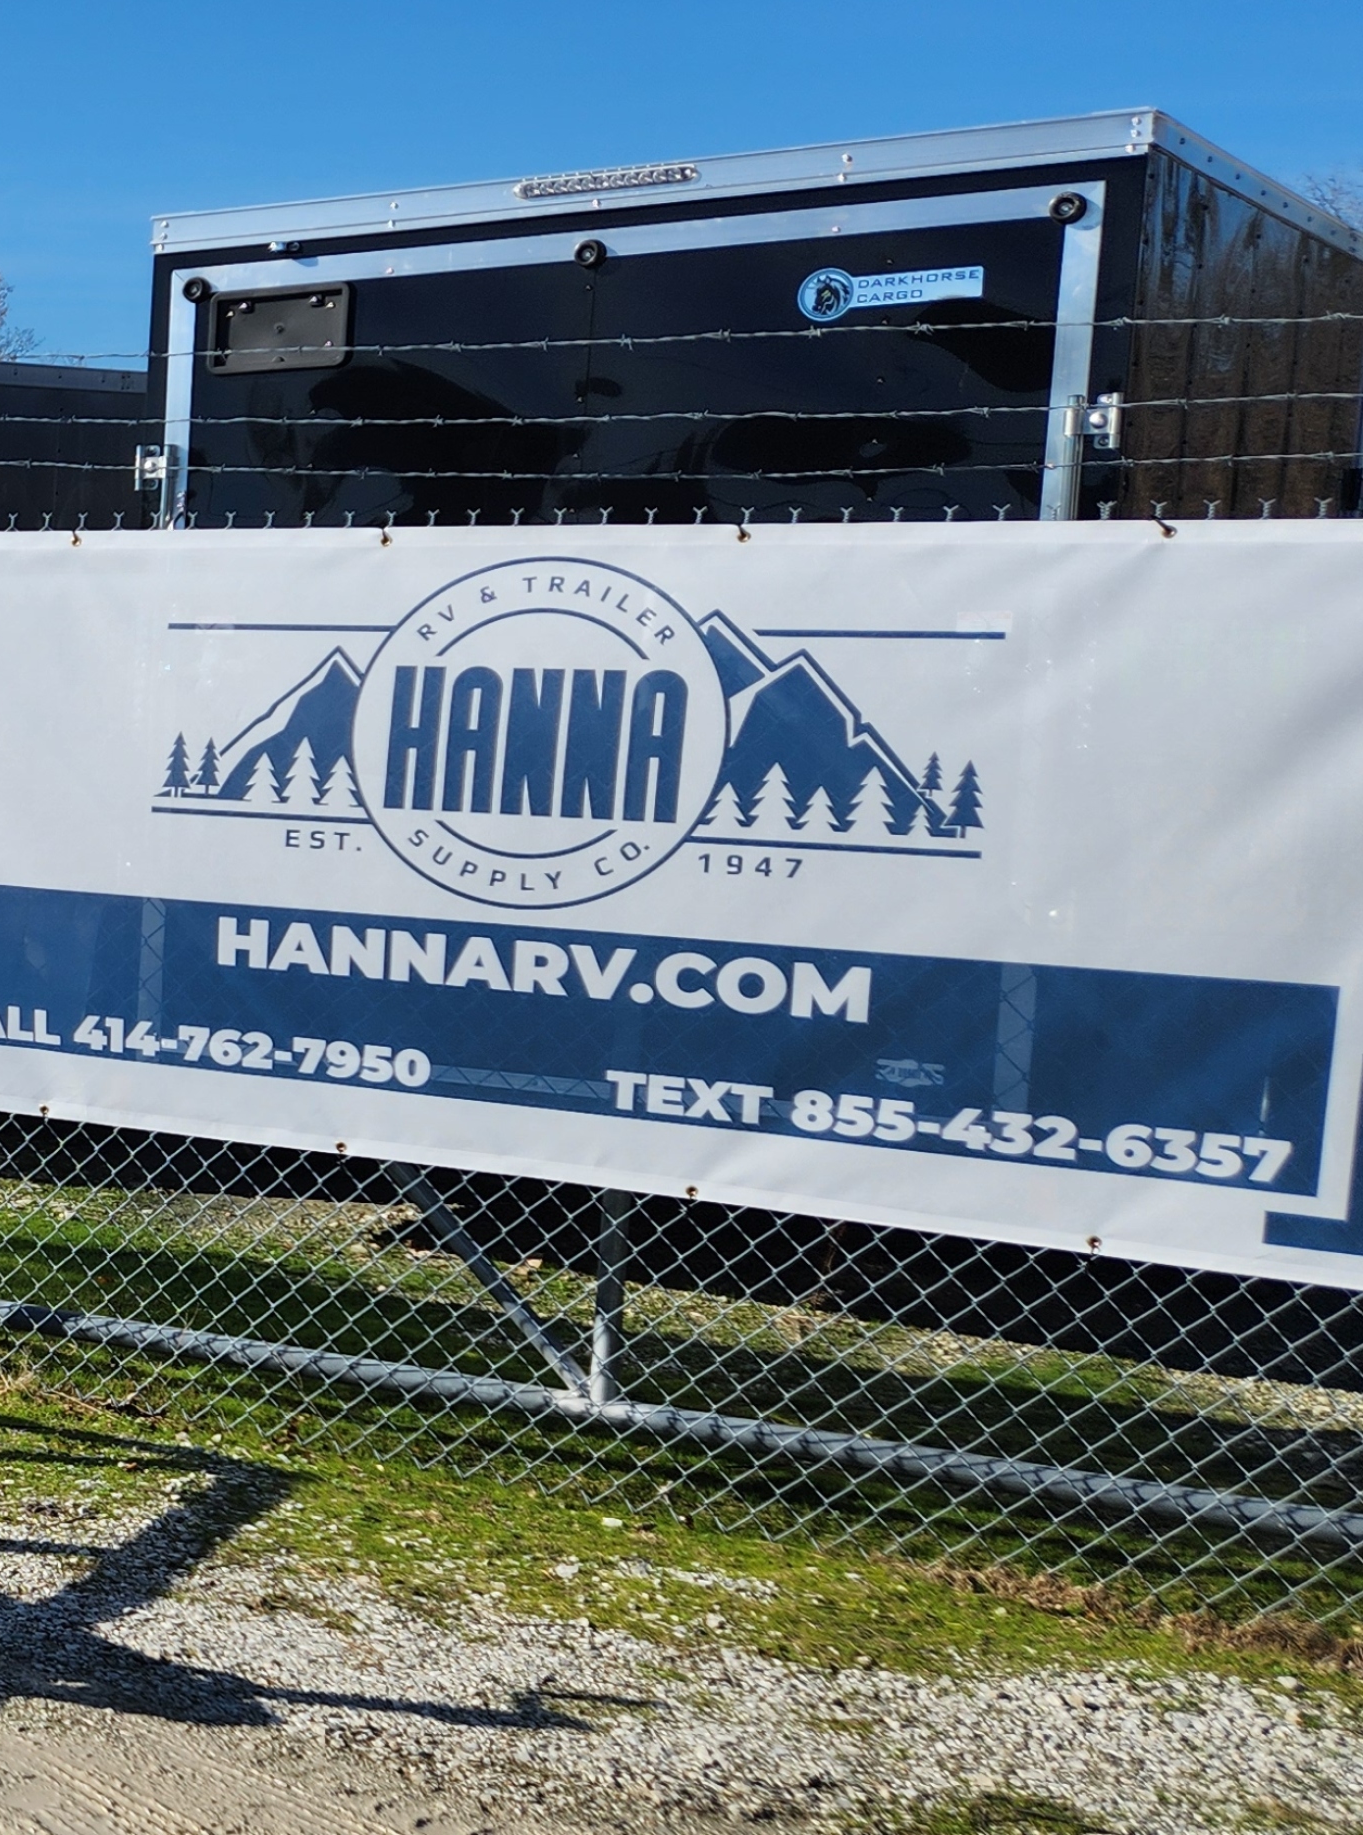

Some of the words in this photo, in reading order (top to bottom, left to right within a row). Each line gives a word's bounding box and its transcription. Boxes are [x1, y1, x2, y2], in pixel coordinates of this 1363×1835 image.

[857, 289, 922, 304] CARGO
[858, 269, 980, 289] DARKHORSE
[417, 604, 455, 642] RV
[480, 585, 497, 604] &
[522, 576, 676, 645] TRAILER
[383, 665, 689, 824] HANNA
[284, 829, 364, 852] EST.
[408, 828, 562, 891] SUPPLY
[594, 841, 650, 877] CO.
[697, 852, 806, 880] 1947
[217, 916, 871, 1024] HANNARV.COM
[73, 1014, 432, 1088] 414-762-7950
[606, 1069, 773, 1125] TEXT
[790, 1088, 1293, 1183] 855-432-6357
